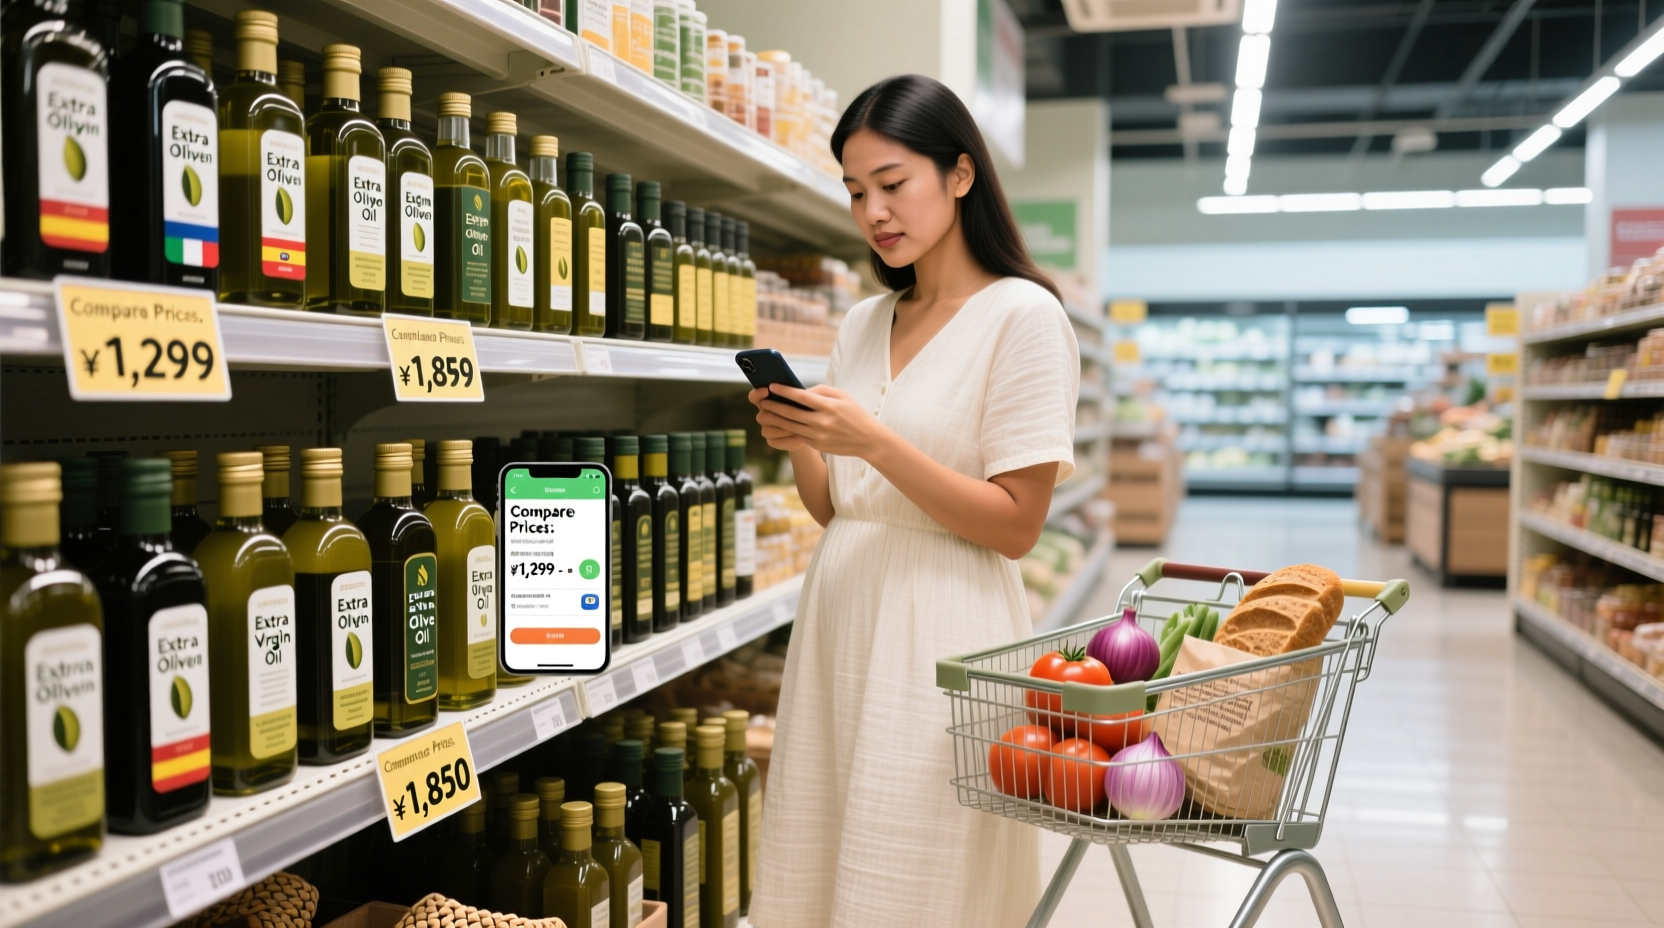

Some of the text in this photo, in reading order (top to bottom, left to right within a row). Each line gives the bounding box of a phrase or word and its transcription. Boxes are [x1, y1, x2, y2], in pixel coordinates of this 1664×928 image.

[48, 91, 96, 116] Extra
[172, 125, 209, 146] Extra
[267, 152, 300, 170] Extra
[354, 177, 382, 192] Extra
[362, 208, 376, 222] Oil
[70, 298, 148, 322] Compare
[80, 336, 214, 388] ¥1,299
[399, 355, 474, 393] ¥1,859
[510, 505, 575, 521] Compare
[338, 598, 368, 612] Extra
[477, 596, 489, 610] Oil
[255, 615, 289, 630] Extra
[158, 636, 198, 654] Extra
[265, 650, 282, 665] Oil
[393, 757, 470, 820] ¥1,850
